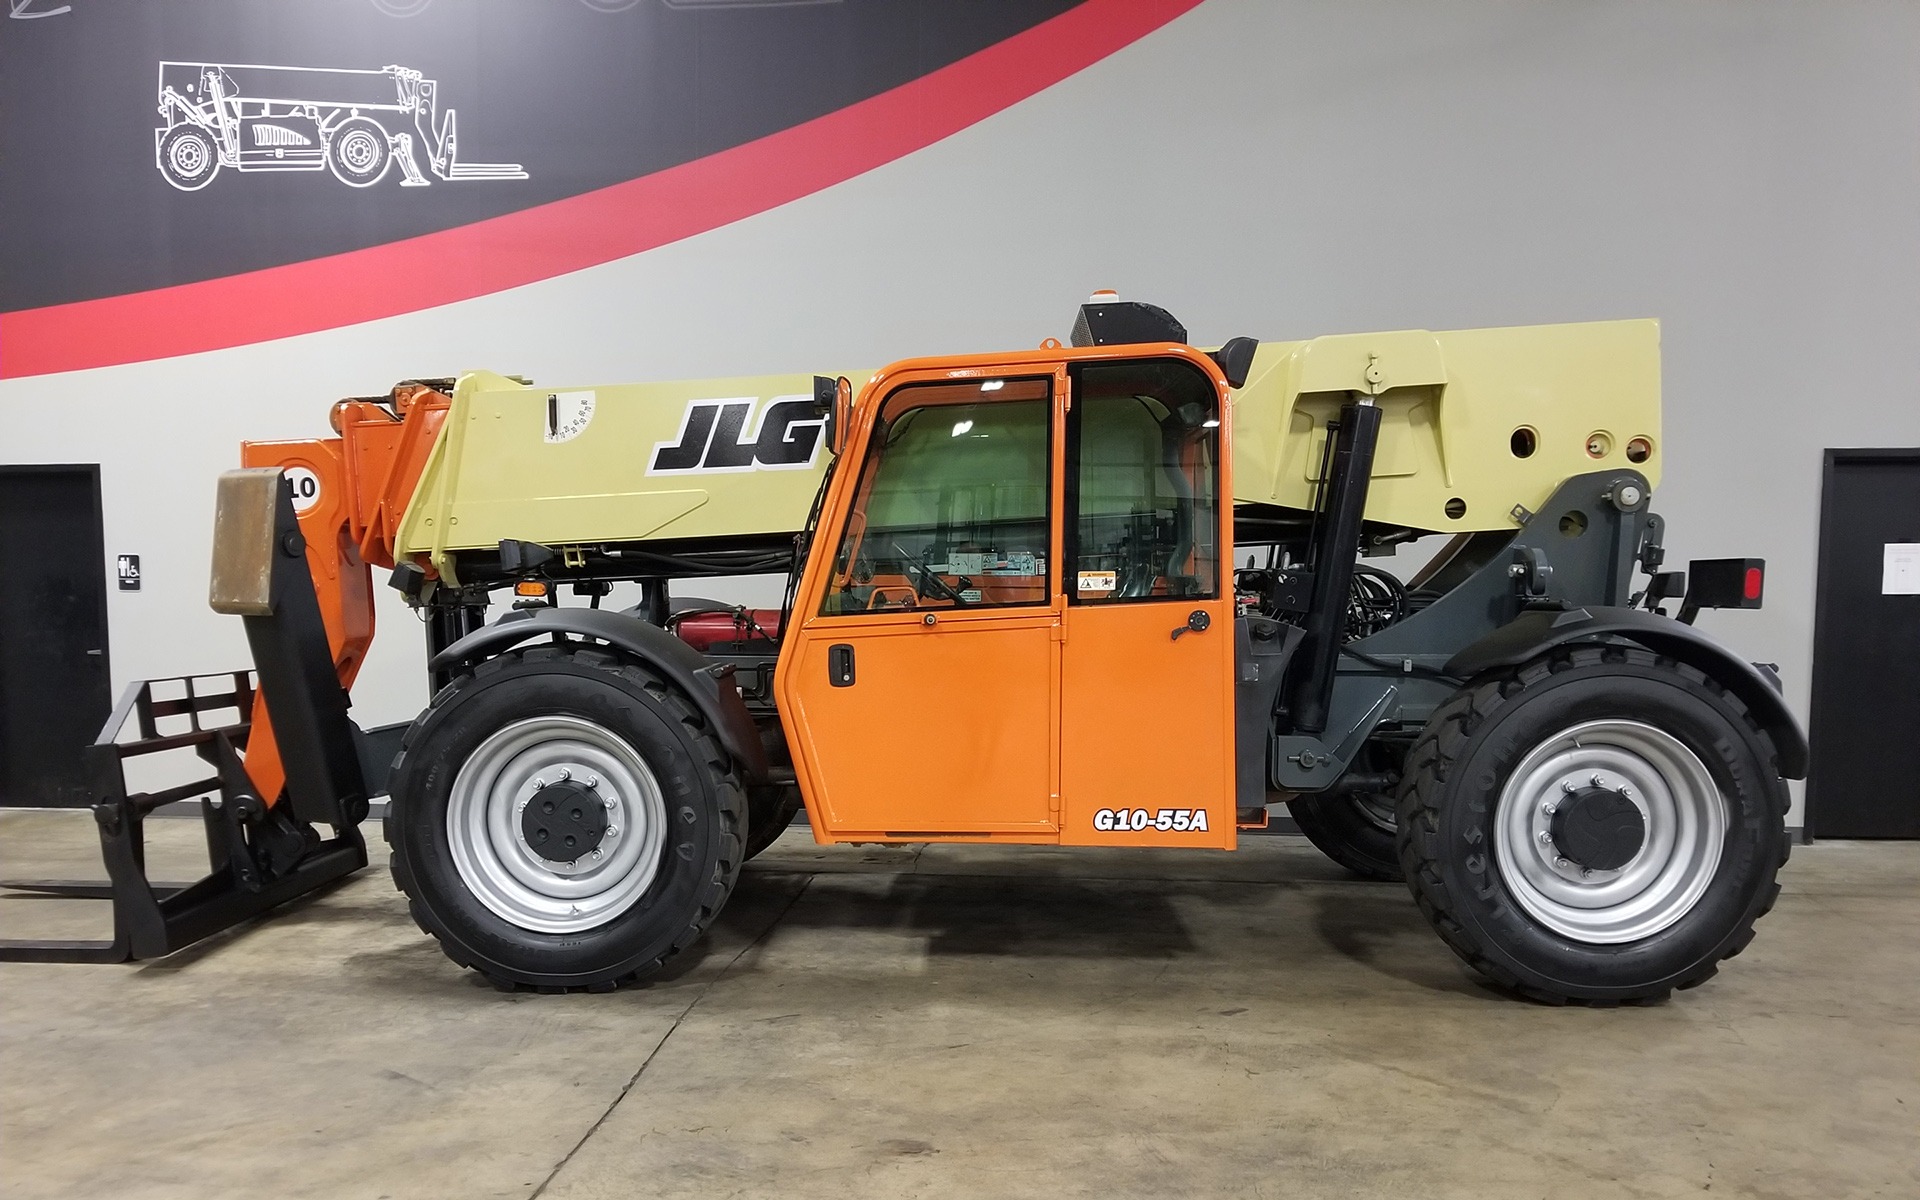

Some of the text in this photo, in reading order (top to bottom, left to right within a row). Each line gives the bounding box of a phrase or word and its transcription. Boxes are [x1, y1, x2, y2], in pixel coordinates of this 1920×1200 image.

[649, 397, 830, 473] JLG
[286, 476, 316, 498] 10
[1093, 807, 1210, 832] G10-55A
